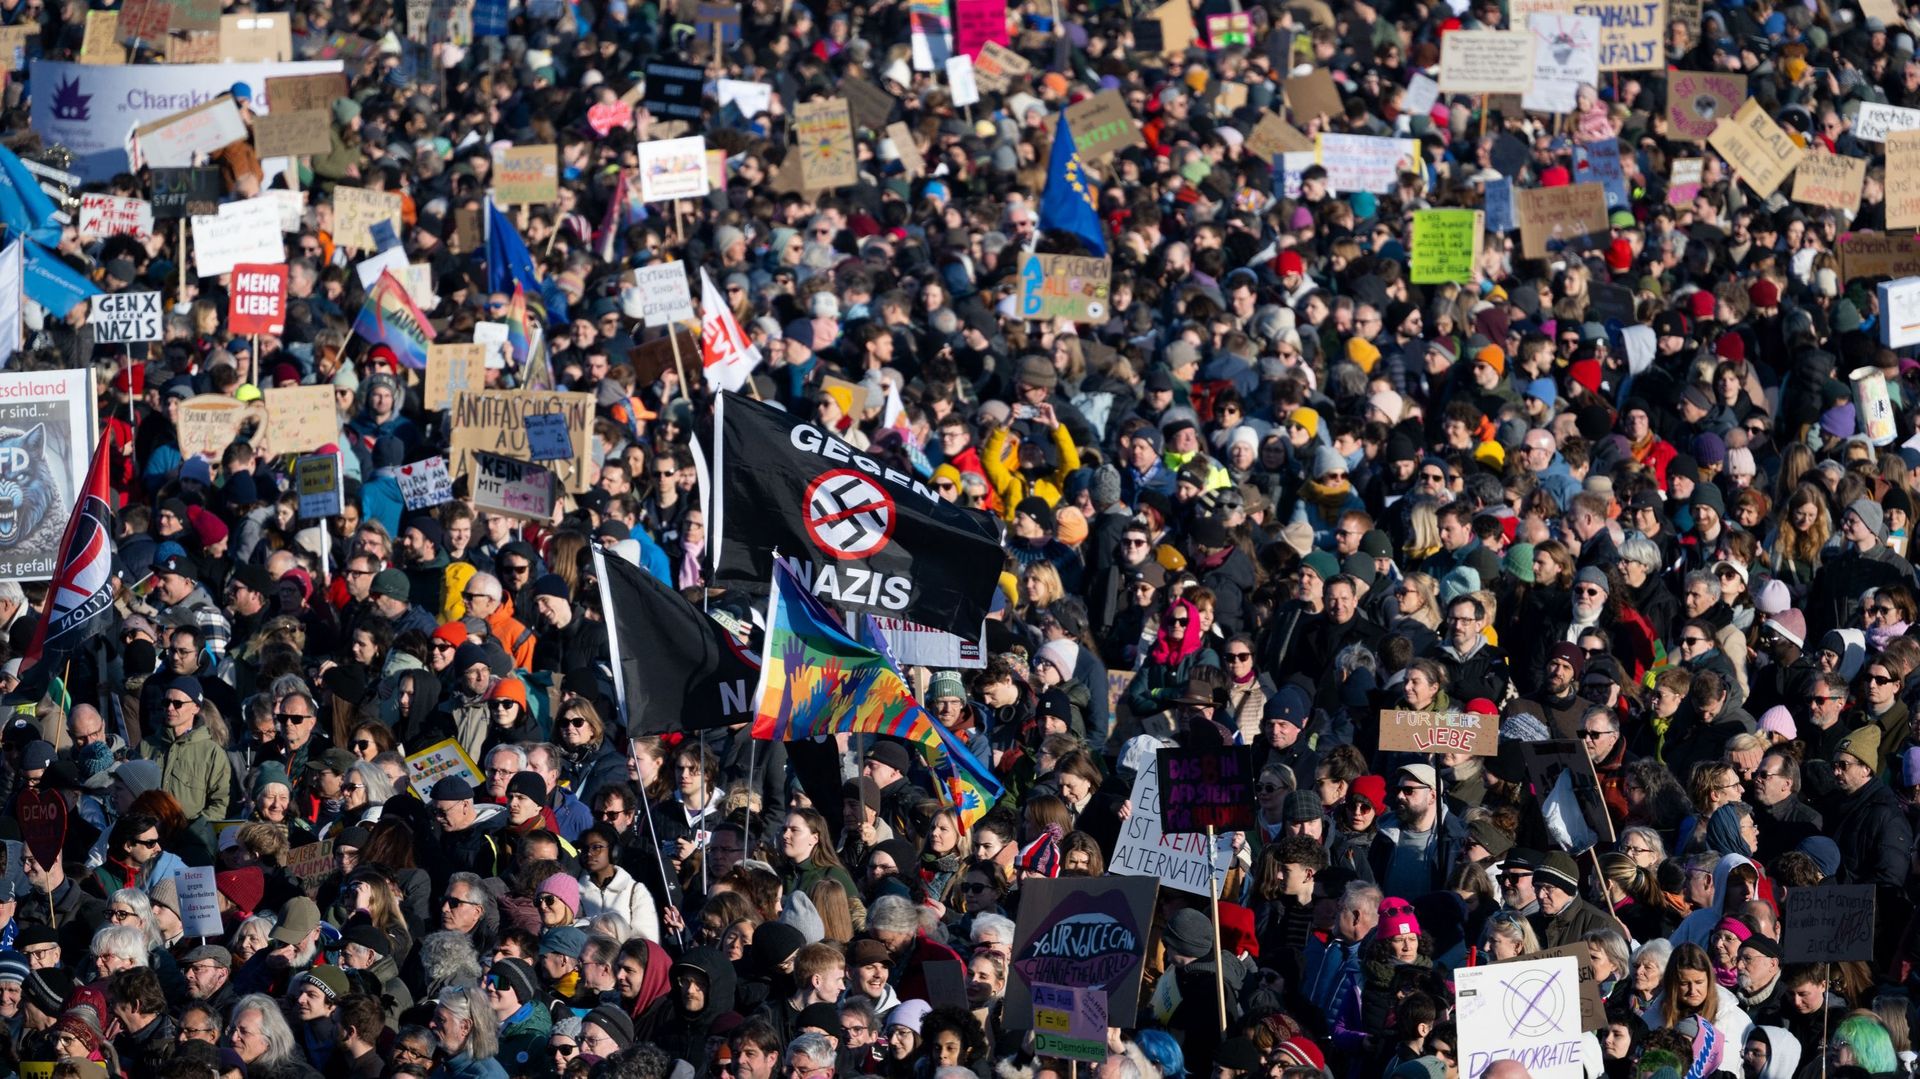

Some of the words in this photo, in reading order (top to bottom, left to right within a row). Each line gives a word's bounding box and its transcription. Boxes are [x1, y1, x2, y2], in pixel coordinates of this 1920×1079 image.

[236, 273, 281, 293] MEHR
[99, 295, 143, 313] GEN
[143, 294, 157, 313] X
[235, 295, 279, 316] LIEBE
[95, 319, 156, 341] NAZIS
[482, 455, 523, 483] KEIN
[789, 423, 941, 504] GEGEN
[478, 479, 502, 494] MIT
[788, 556, 913, 611] NAZIS
[1395, 711, 1431, 728] FÜR
[1434, 713, 1482, 729] MEHR
[1413, 728, 1478, 751] LIEBE
[1168, 758, 1200, 781] DAS
[23, 803, 58, 821] DEMO
[1128, 815, 1154, 841] IST
[1109, 926, 1136, 951] CAN
[1025, 958, 1073, 986] CHANGE
[1088, 954, 1130, 983] WORLD
[1034, 988, 1045, 1004] A
[1036, 1011, 1043, 1027] f
[1036, 1034, 1046, 1050] D
[1057, 1040, 1106, 1057] Demokratie
